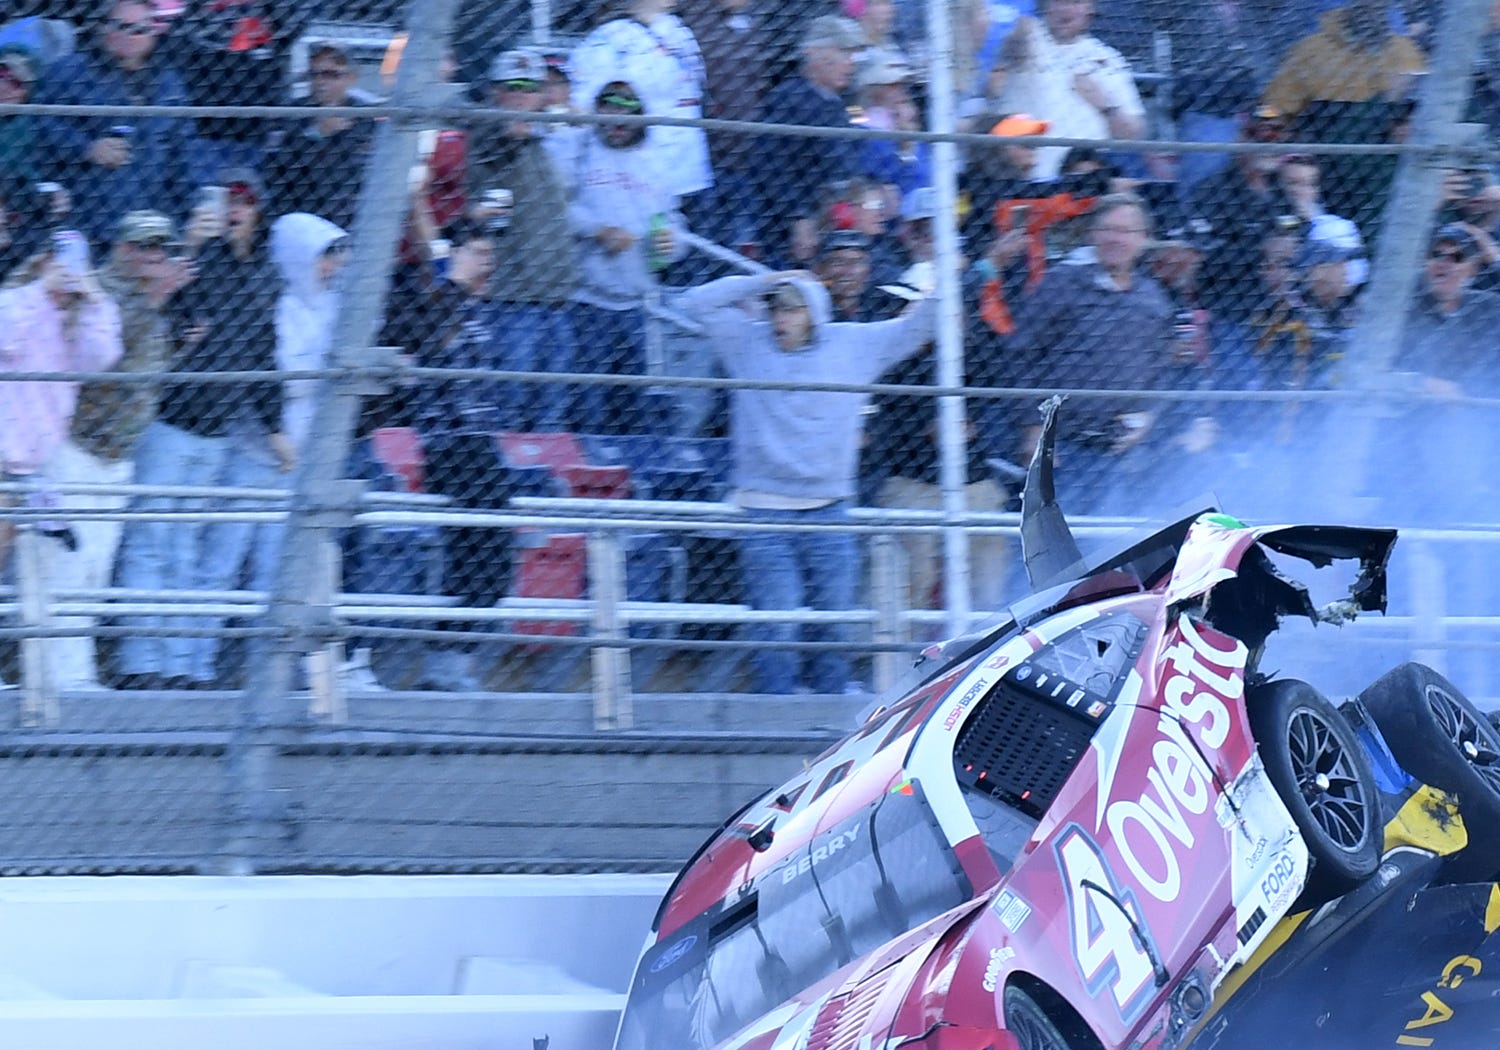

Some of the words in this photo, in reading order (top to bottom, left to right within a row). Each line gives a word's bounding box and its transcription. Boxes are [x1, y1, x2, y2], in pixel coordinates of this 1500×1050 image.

[944, 700, 965, 732] JOSH
[960, 677, 988, 707] BERRY
[781, 823, 861, 885] BERRY
[1260, 854, 1296, 904] FORD
[1052, 821, 1168, 1029] 4
